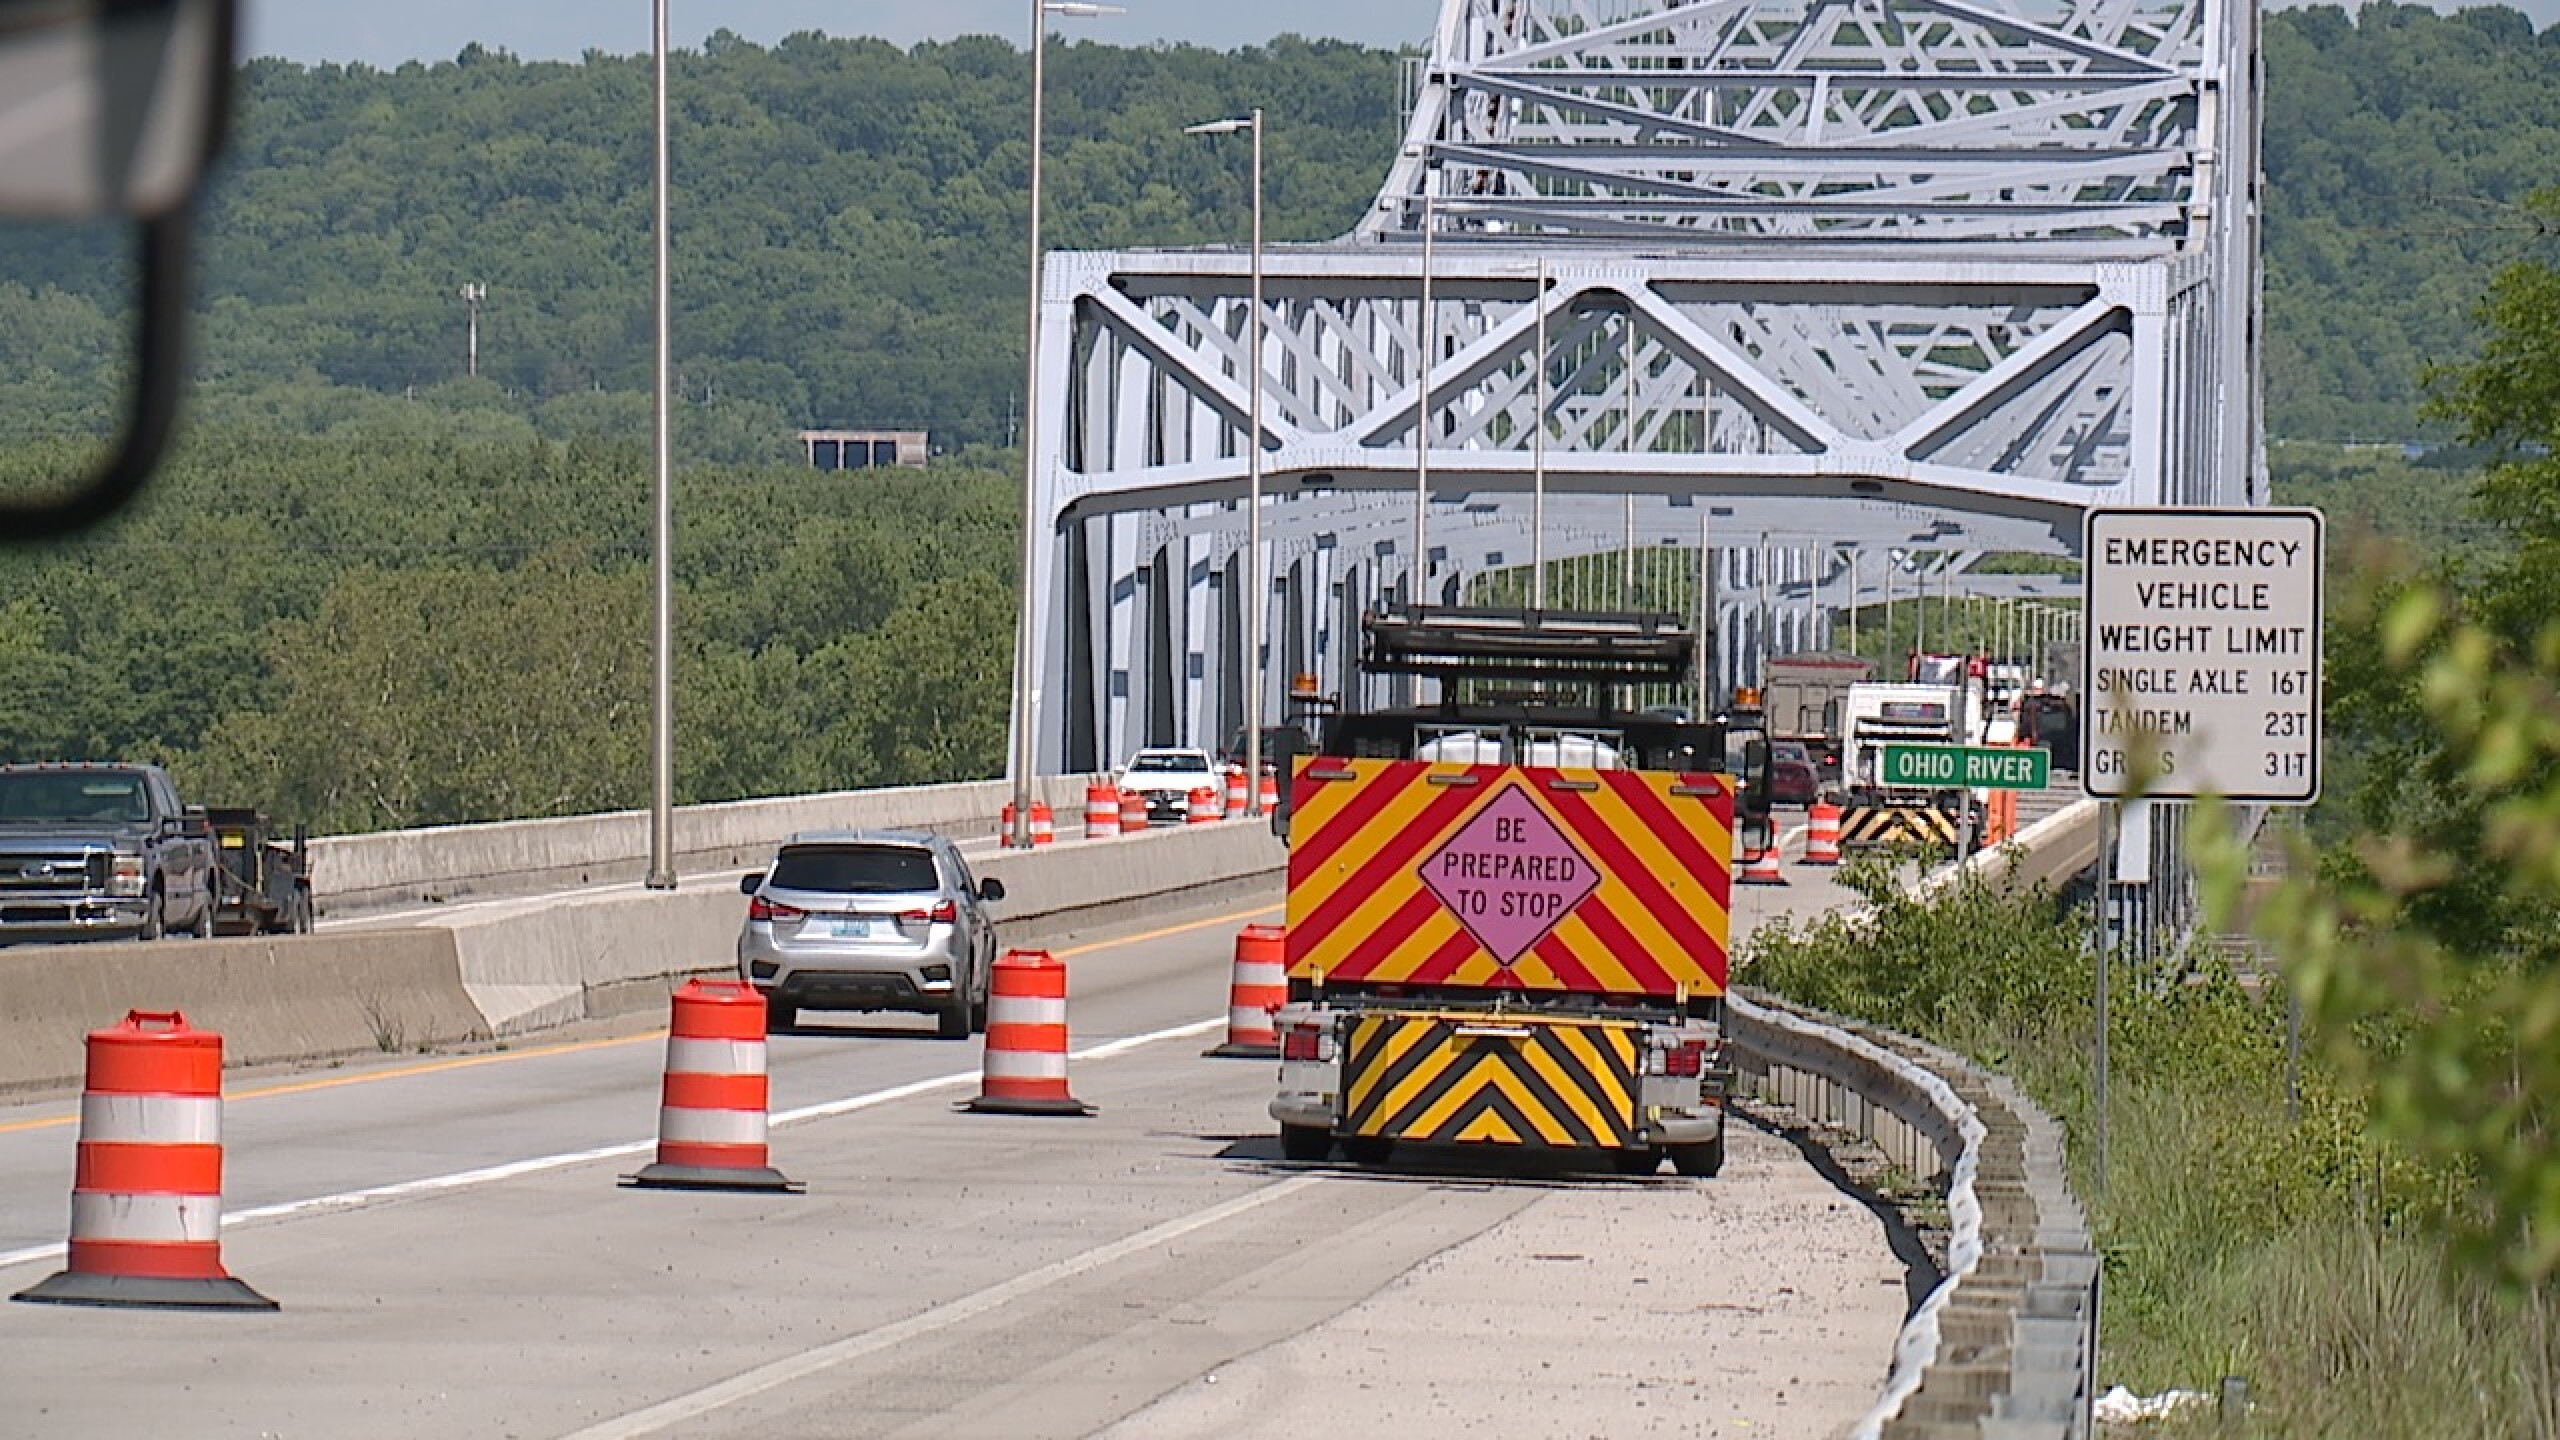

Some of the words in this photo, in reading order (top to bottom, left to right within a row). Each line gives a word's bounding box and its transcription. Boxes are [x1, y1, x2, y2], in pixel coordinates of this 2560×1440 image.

[2105, 537, 2299, 567] EMERGENCY
[2137, 582, 2271, 610] VEHICLE
[2100, 625, 2212, 653] WEIGHT
[2227, 628, 2304, 654] LIMIT
[2097, 668, 2177, 693] SINGLE
[2189, 670, 2248, 694] AXLE
[2271, 671, 2308, 695] 16T
[2096, 709, 2191, 735] TANDEM
[2264, 712, 2307, 737] 23T
[1899, 751, 1954, 778] OHIO
[1967, 756, 2033, 782] RIVER
[2095, 750, 2175, 775] GRS
[2264, 753, 2308, 777] 31T
[1496, 817, 1527, 843] BE
[1443, 852, 1576, 882] PREPARED
[1458, 890, 1487, 915] TO
[1500, 891, 1563, 918] STOP
